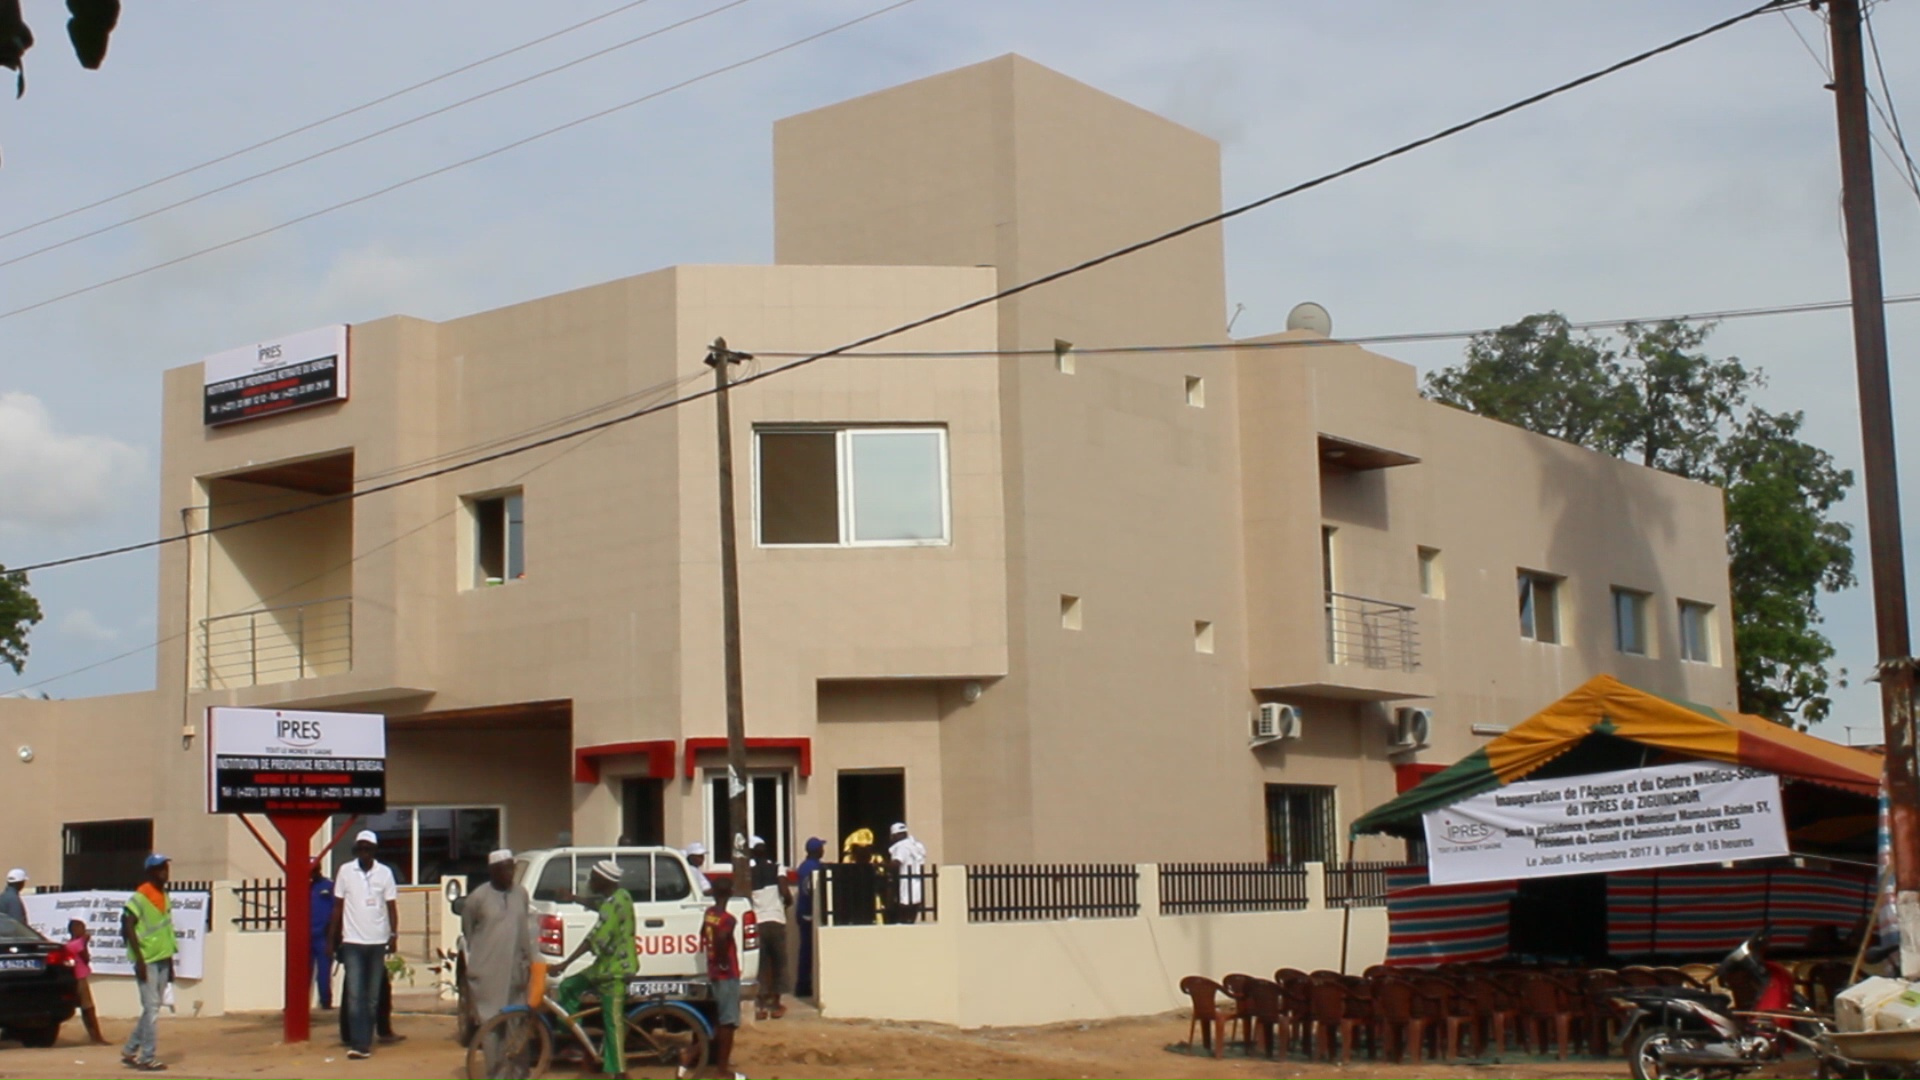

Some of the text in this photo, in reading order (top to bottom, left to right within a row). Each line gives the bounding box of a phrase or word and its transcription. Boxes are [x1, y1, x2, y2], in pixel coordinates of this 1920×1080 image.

[1496, 790, 1561, 808] Inauguration
[1564, 788, 1577, 800] de
[1627, 780, 1638, 793] et
[1640, 777, 1654, 790] du
[1656, 774, 1691, 790] Centre
[1566, 804, 1579, 816] de
[1621, 798, 1634, 810] de
[1637, 790, 1700, 808] ZIGUINCHOR
[1504, 828, 1525, 838] Sous
[1527, 826, 1535, 836] la
[1536, 822, 1583, 838] présidence
[1585, 817, 1621, 831] effective
[1624, 815, 1634, 826] de
[1636, 812, 1676, 825] Monsieur
[1679, 807, 1721, 820] Mamadou
[1724, 804, 1754, 816] Racine
[1534, 835, 1573, 849] Président
[1576, 834, 1588, 845] du
[1590, 830, 1620, 844] Conseil
[1622, 823, 1694, 841] d'Administration
[1695, 822, 1706, 834] de
[1526, 838, 1754, 867] Le Jeudi 14 Septembre 2017 à partir de 16 heures
